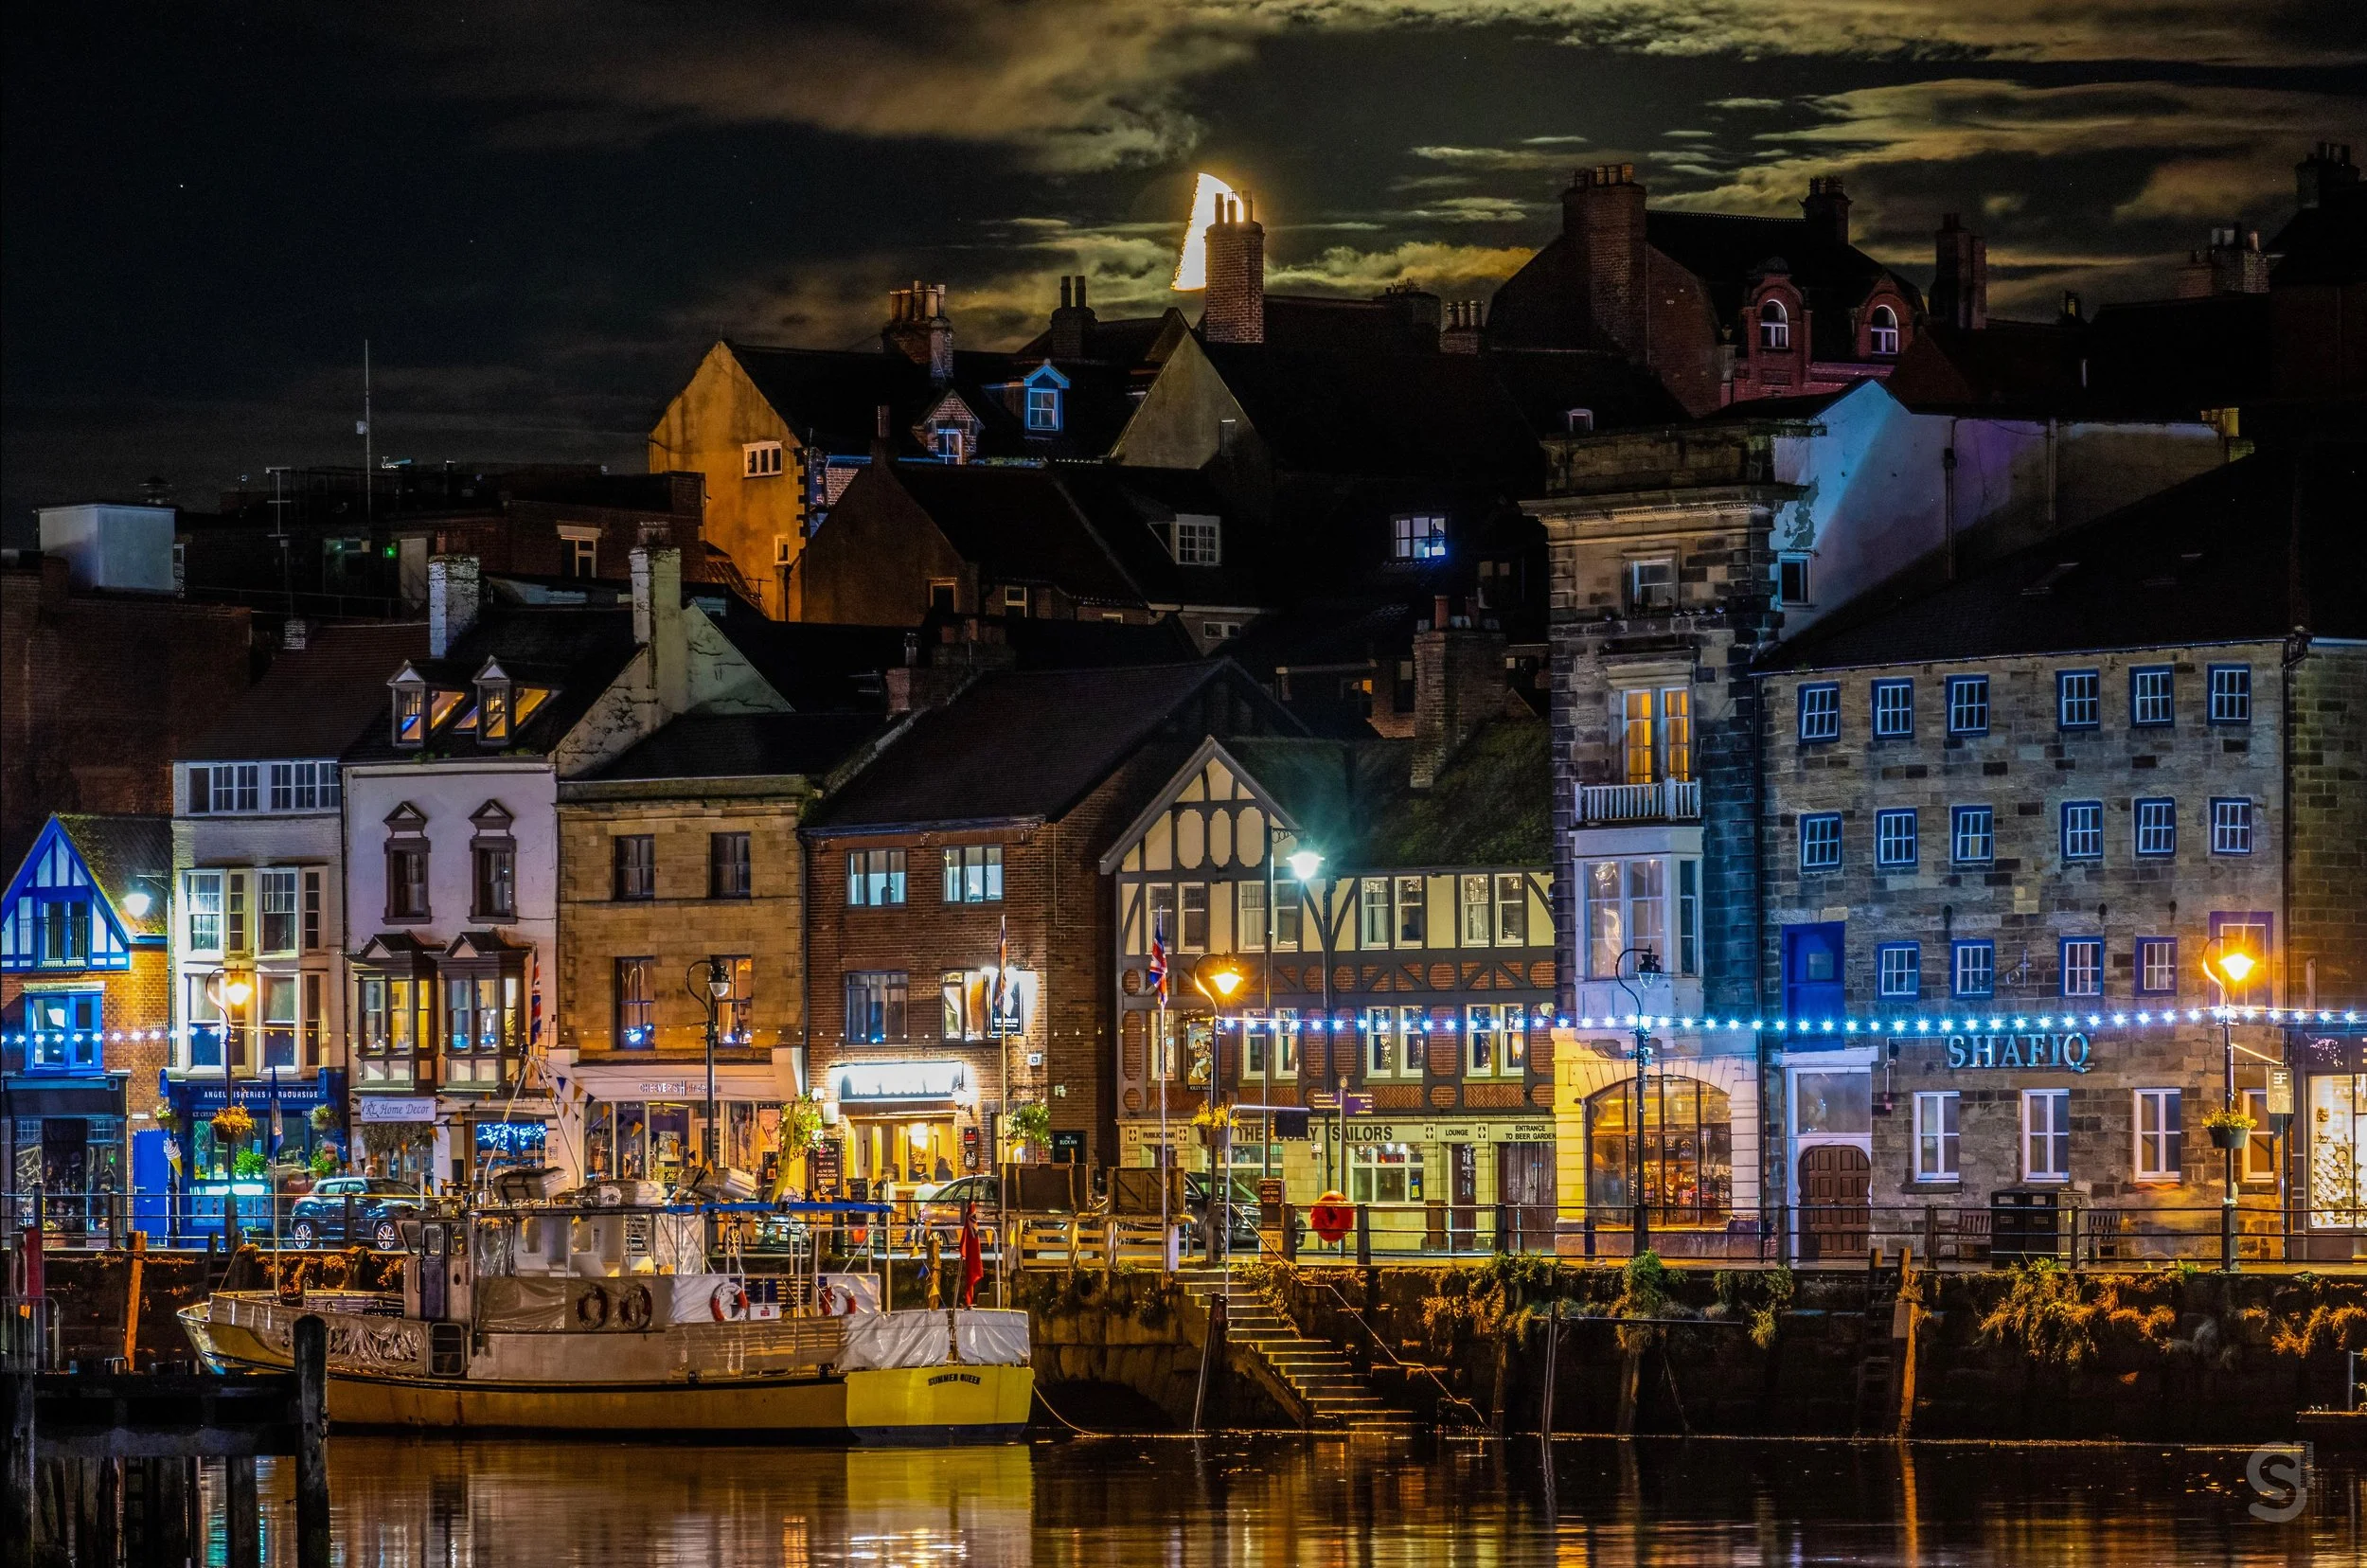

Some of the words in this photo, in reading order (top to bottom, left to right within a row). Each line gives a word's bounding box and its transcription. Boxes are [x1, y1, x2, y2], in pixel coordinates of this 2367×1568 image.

[1948, 1032, 2090, 1073] SHAFIQ
[380, 1103, 402, 1114] Home
[405, 1103, 430, 1114] Decor
[1237, 1126, 1264, 1142] THE
